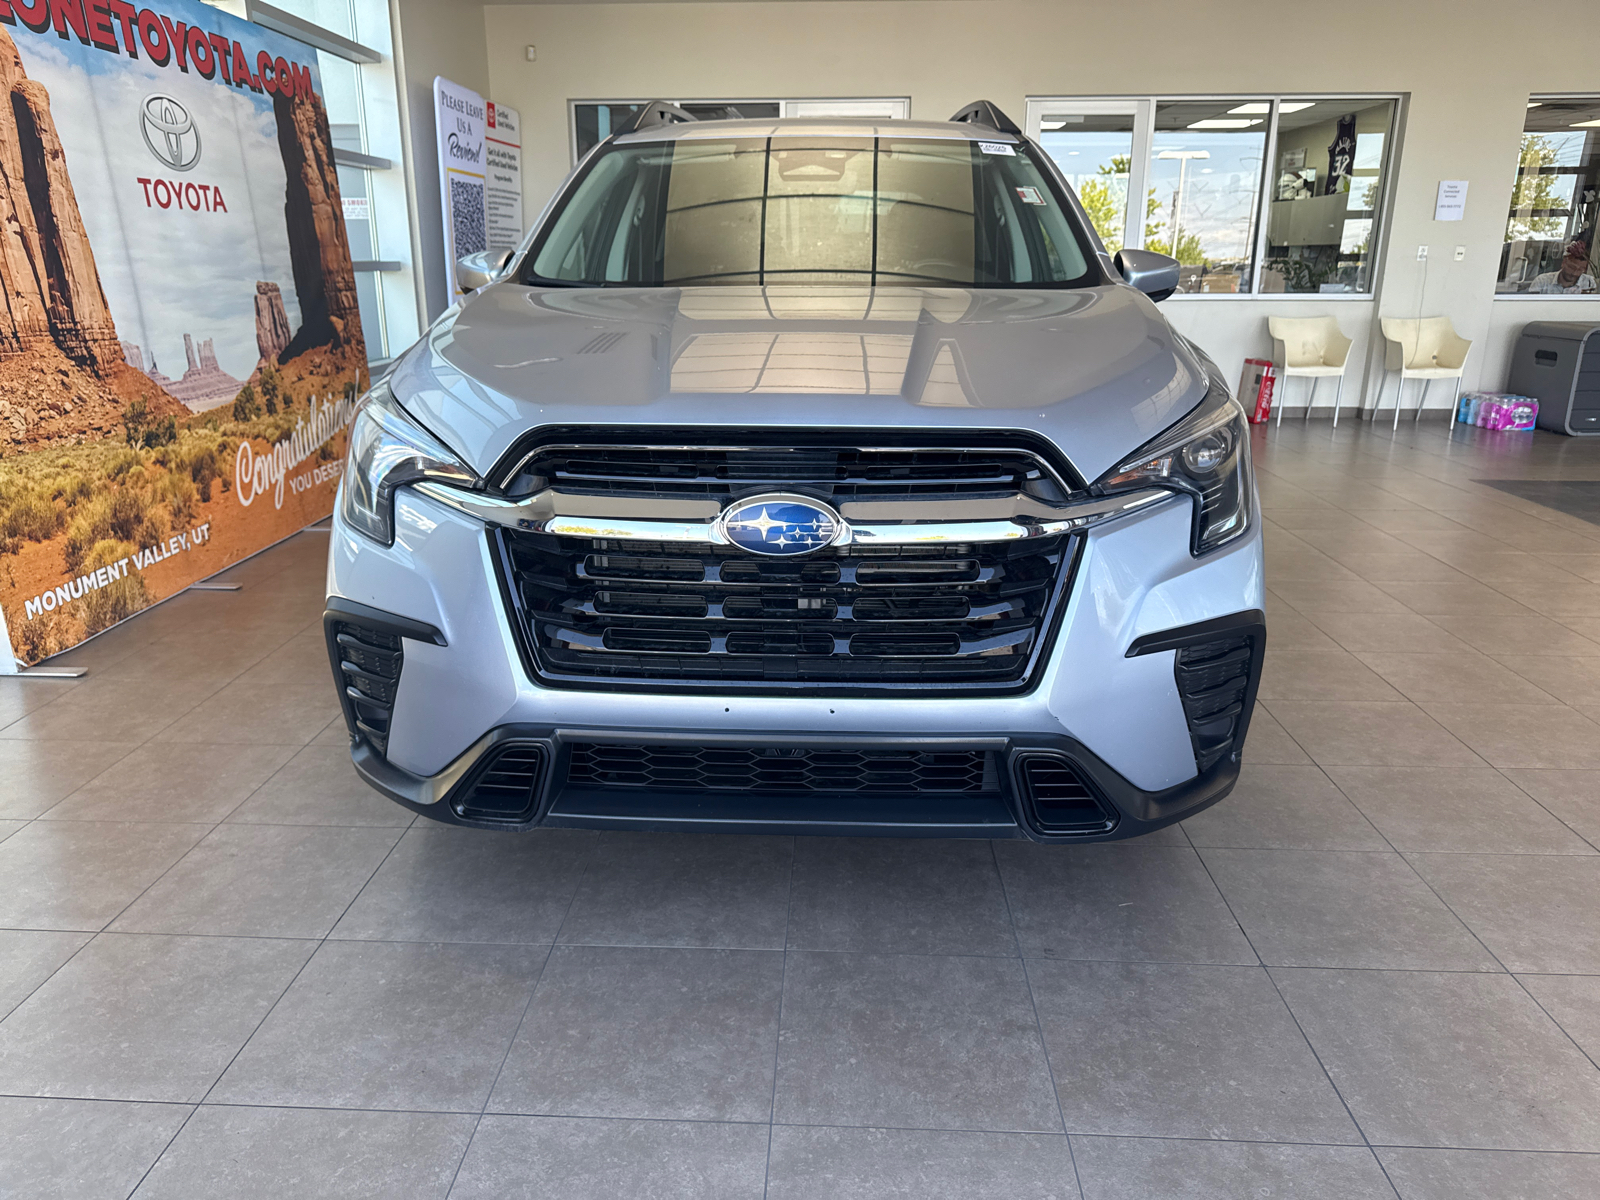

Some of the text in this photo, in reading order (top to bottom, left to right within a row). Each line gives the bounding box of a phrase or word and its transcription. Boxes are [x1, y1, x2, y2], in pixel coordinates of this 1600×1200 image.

[0, 0, 314, 99] NETOYOTA.COM
[441, 90, 484, 121] PLEASE LEAVE
[467, 121, 473, 136] A
[447, 132, 482, 164] Review!
[1331, 154, 1350, 177] 32
[137, 177, 228, 213] TOYOTA
[289, 459, 344, 495] YOU DESER
[24, 523, 210, 621] MONUMENT VALLEY, UT
